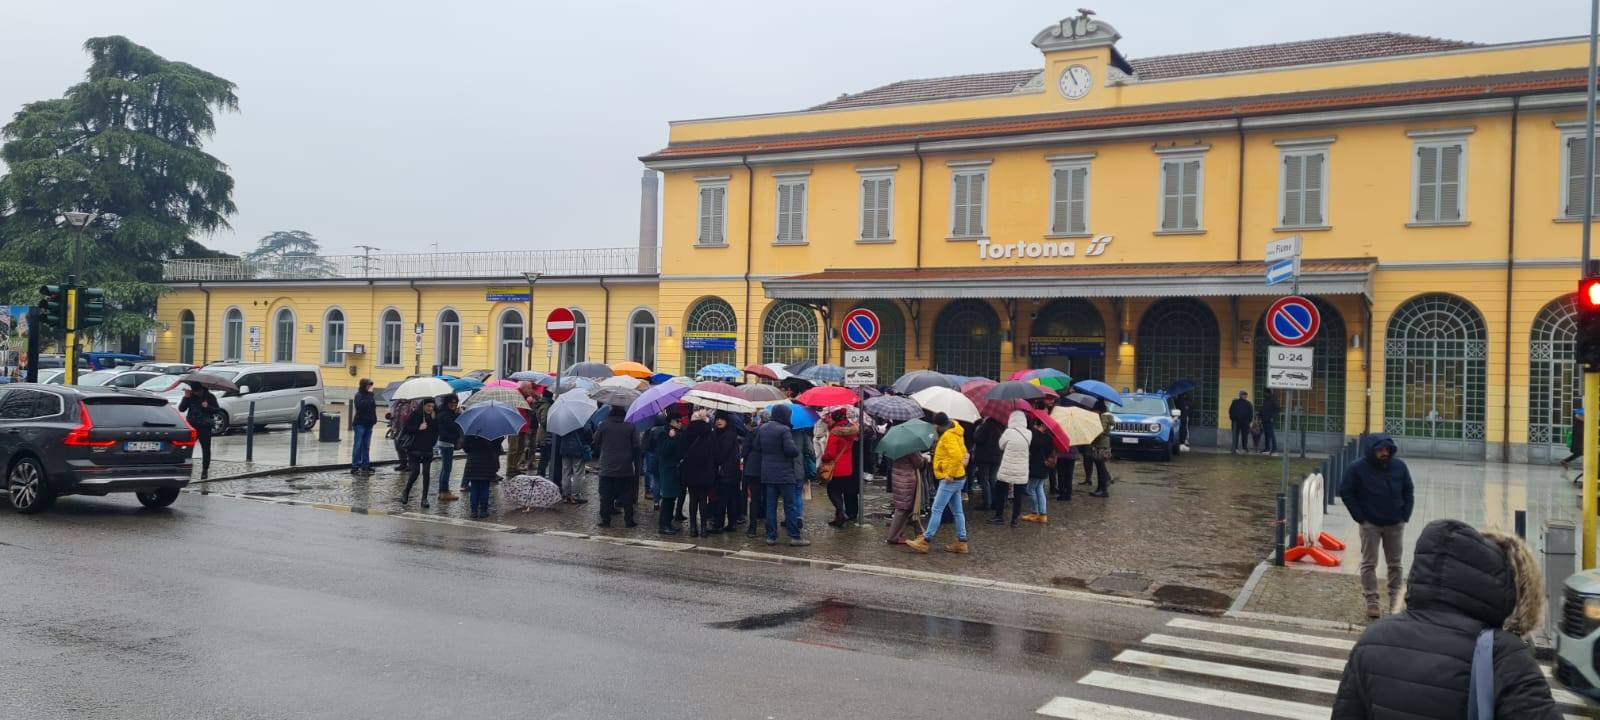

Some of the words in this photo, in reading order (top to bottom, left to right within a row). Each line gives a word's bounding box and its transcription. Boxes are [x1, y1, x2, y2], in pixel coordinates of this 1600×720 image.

[977, 239, 1075, 259] Tortona
[851, 355, 870, 363] 0-24
[1278, 353, 1303, 362] 0-24
